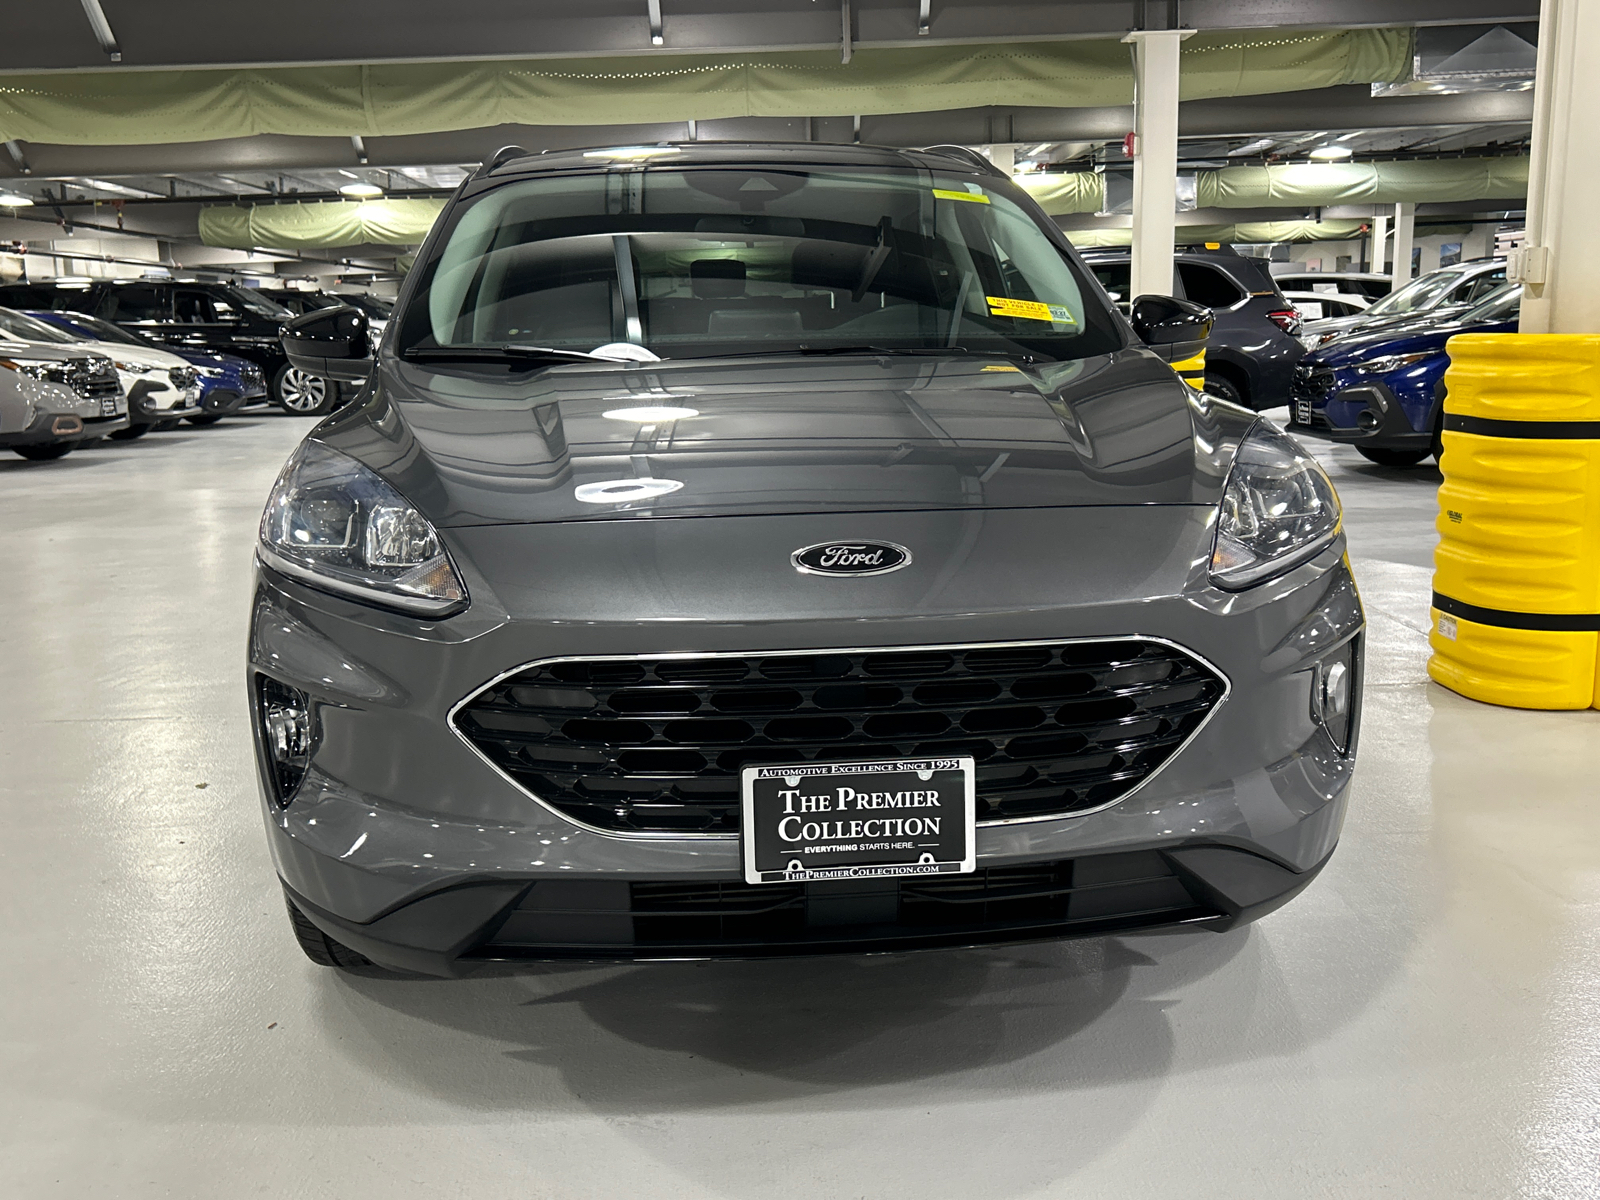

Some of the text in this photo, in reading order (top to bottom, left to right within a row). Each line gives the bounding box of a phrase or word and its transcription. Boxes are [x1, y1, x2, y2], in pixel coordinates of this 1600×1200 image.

[820, 545, 884, 567] Ford
[930, 760, 958, 769] 1995
[804, 841, 916, 854] EVERYTHING STARTS HERE.
